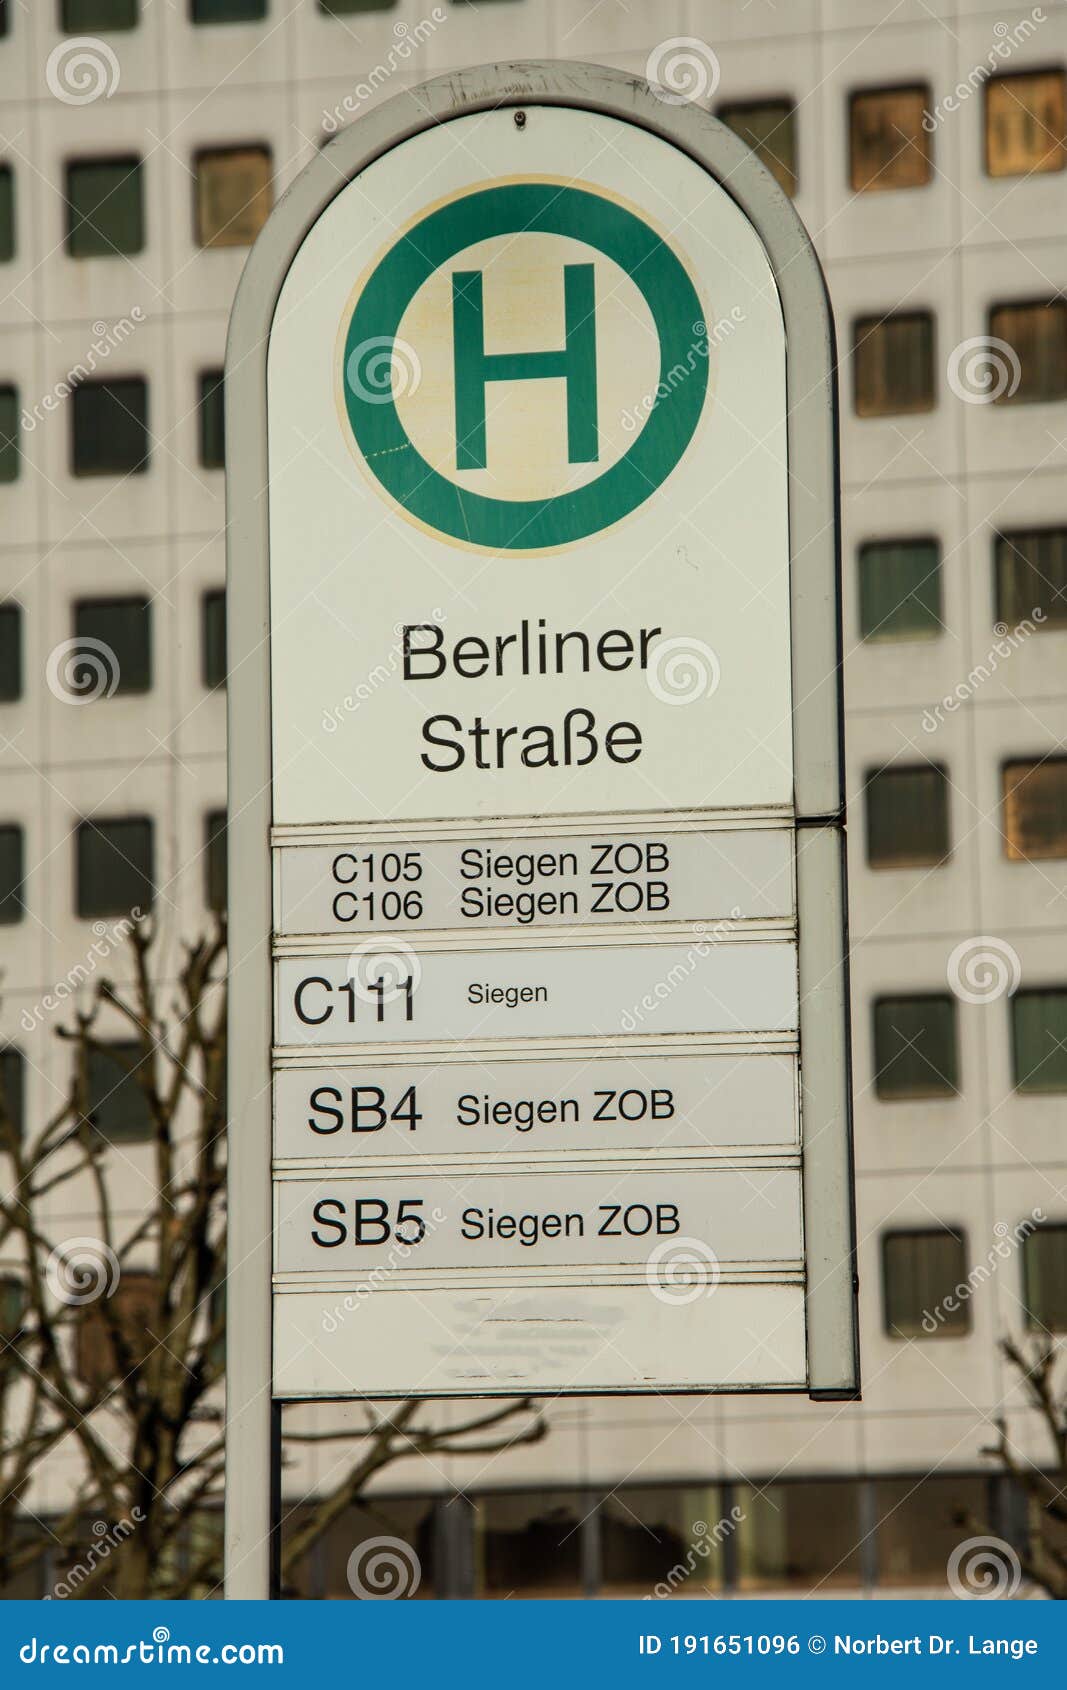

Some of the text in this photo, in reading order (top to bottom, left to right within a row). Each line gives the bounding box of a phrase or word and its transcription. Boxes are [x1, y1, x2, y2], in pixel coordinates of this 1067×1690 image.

[452, 262, 600, 471] H
[402, 619, 662, 681] Berliner
[420, 708, 643, 773] Straße
[332, 842, 670, 886] C105 Siegen ZOB
[332, 881, 670, 923] C106 Siegen ZOB
[294, 976, 548, 1025] C111 Siegen
[308, 1086, 675, 1135] SB4 Siegen ZOB
[311, 1198, 681, 1248] SB5 Siegen ZOB
